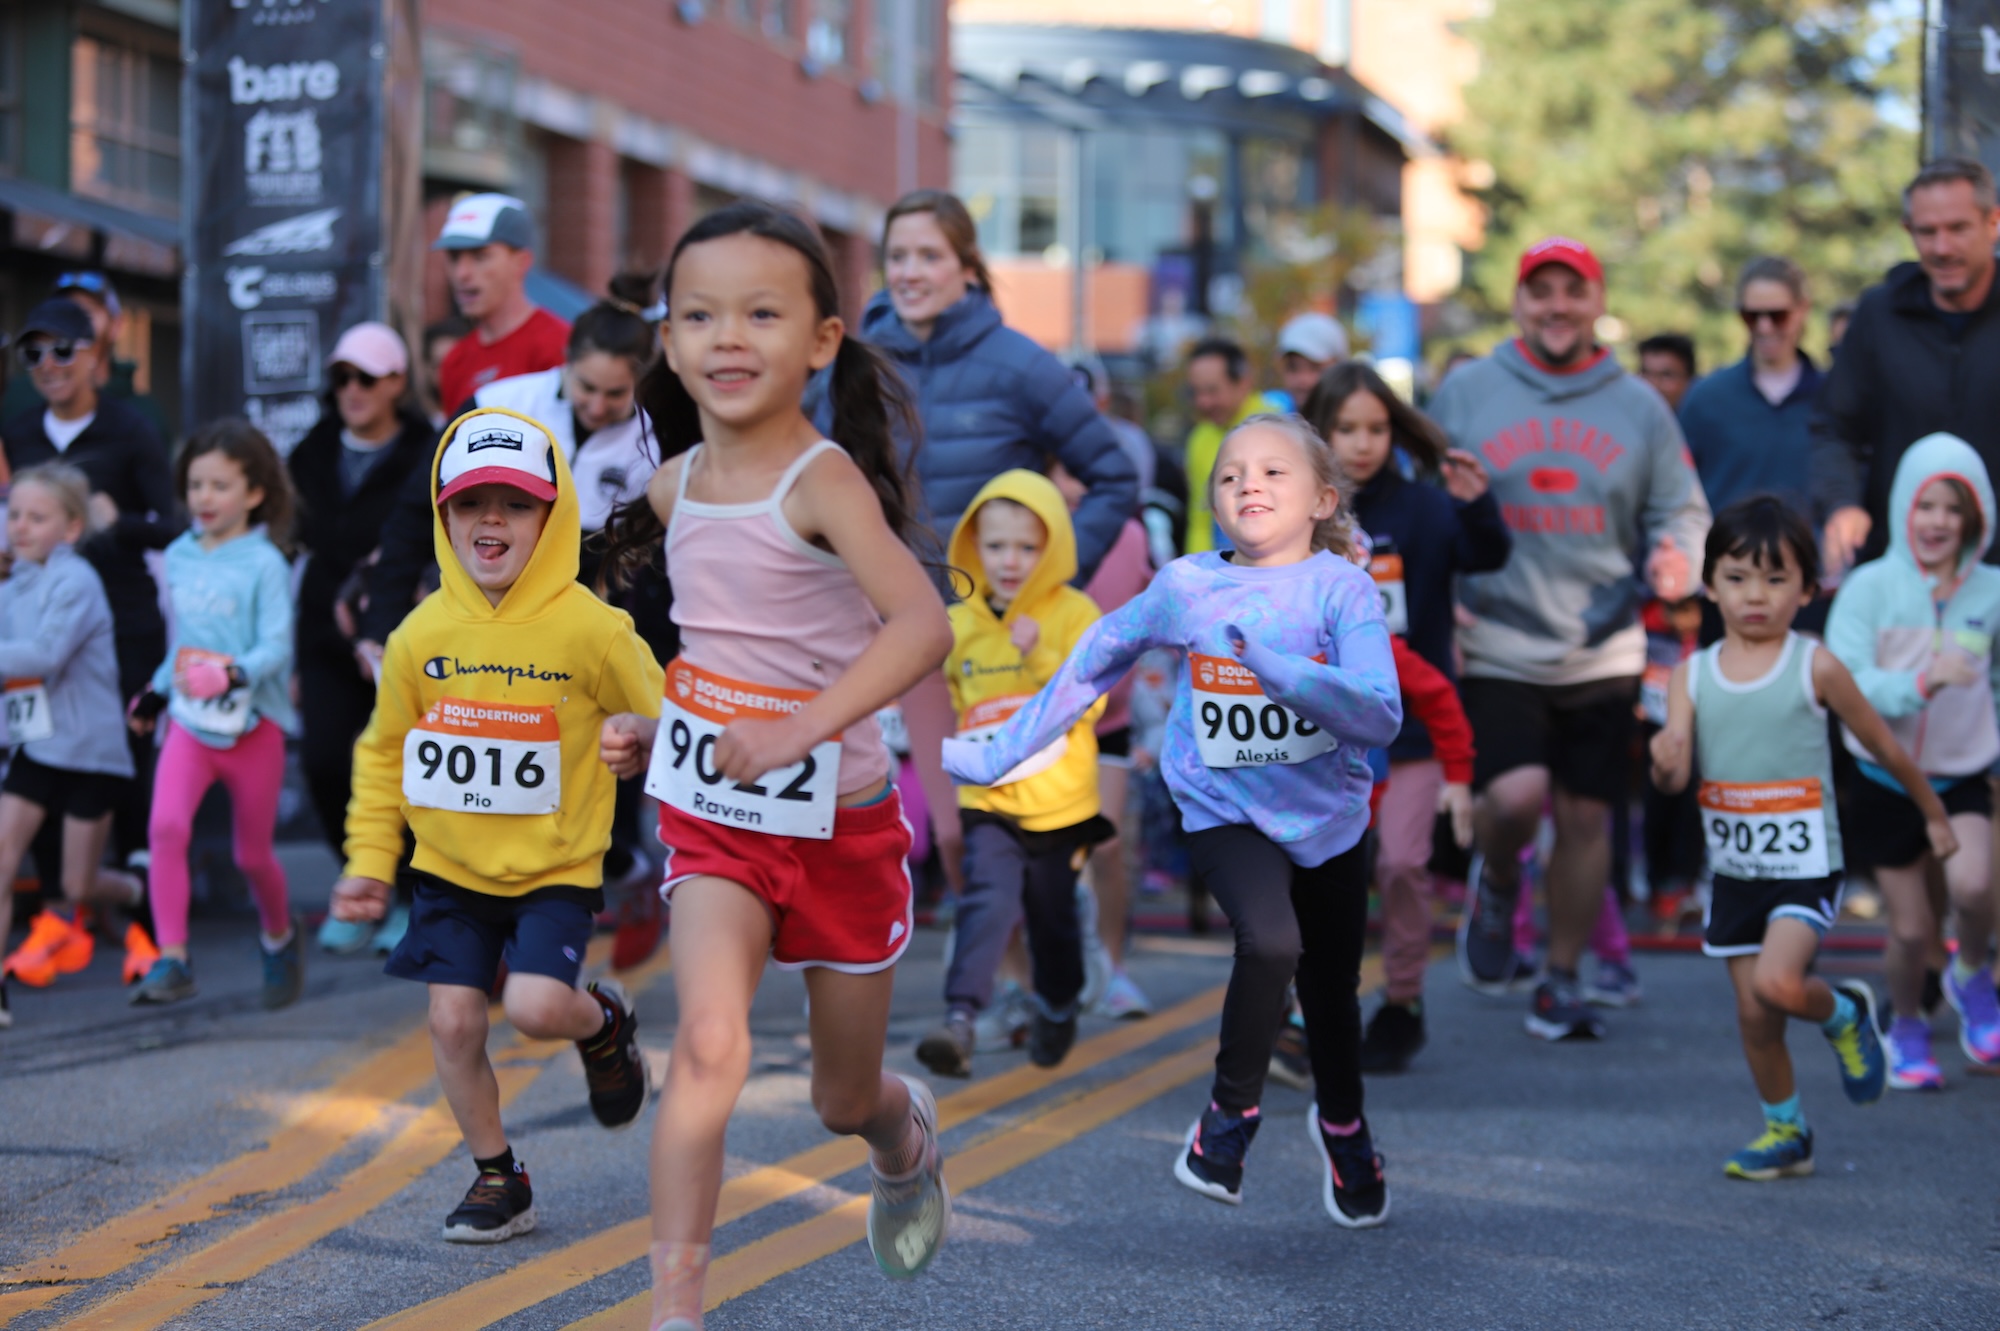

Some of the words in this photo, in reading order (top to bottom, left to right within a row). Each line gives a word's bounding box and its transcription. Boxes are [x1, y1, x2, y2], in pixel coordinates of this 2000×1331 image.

[227, 55, 340, 104] bare
[423, 656, 573, 686] Champion
[694, 678, 809, 715] BOULDERTHO
[443, 703, 541, 725] BOULDERTHON
[443, 717, 460, 727] Kids
[462, 718, 480, 729] Run
[418, 740, 545, 789] 9016
[670, 719, 817, 802] 902
[1235, 748, 1289, 763] Alexis
[463, 792, 492, 808] Pio
[693, 792, 762, 825] Raven
[1712, 818, 1811, 854] 9023
